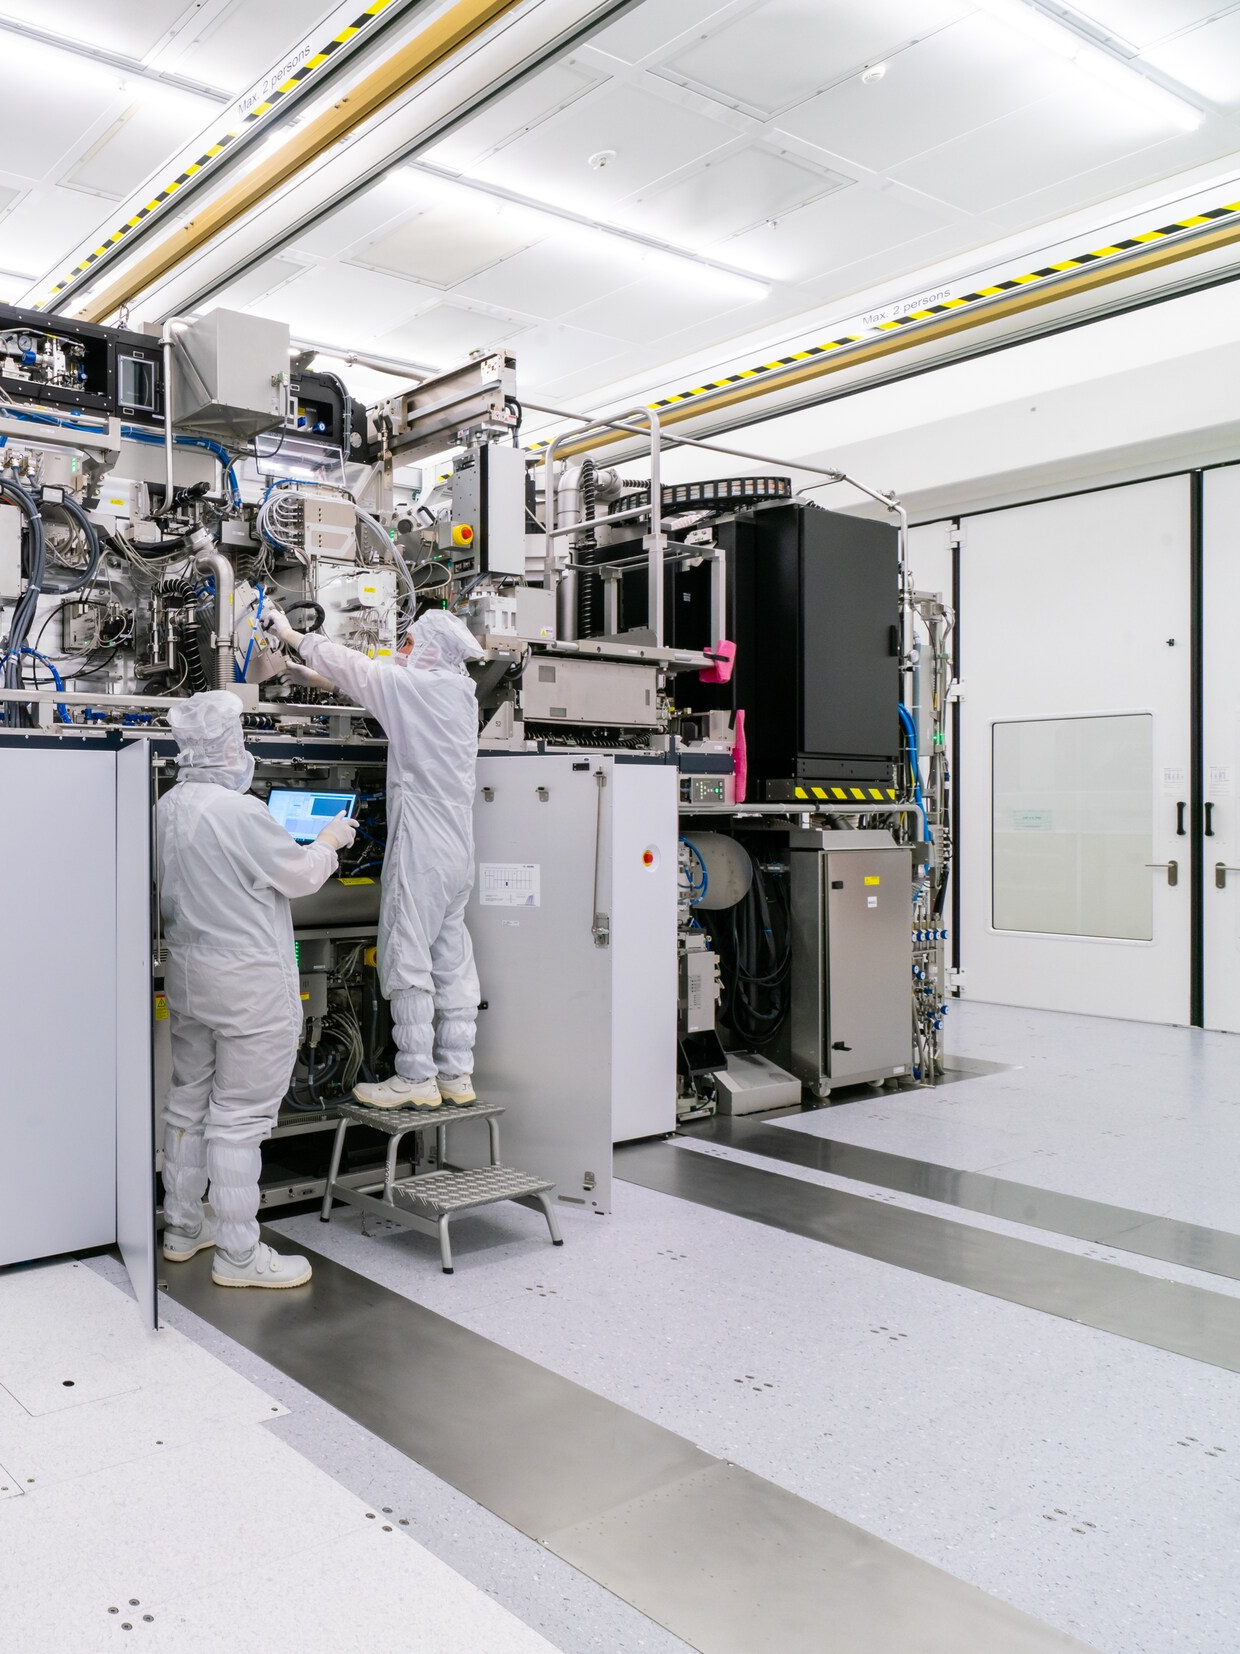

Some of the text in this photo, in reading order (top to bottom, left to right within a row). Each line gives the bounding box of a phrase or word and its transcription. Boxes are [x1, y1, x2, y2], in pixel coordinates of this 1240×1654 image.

[238, 45, 311, 114] Max. 2 persons
[862, 289, 951, 326] Max. 2 persons
